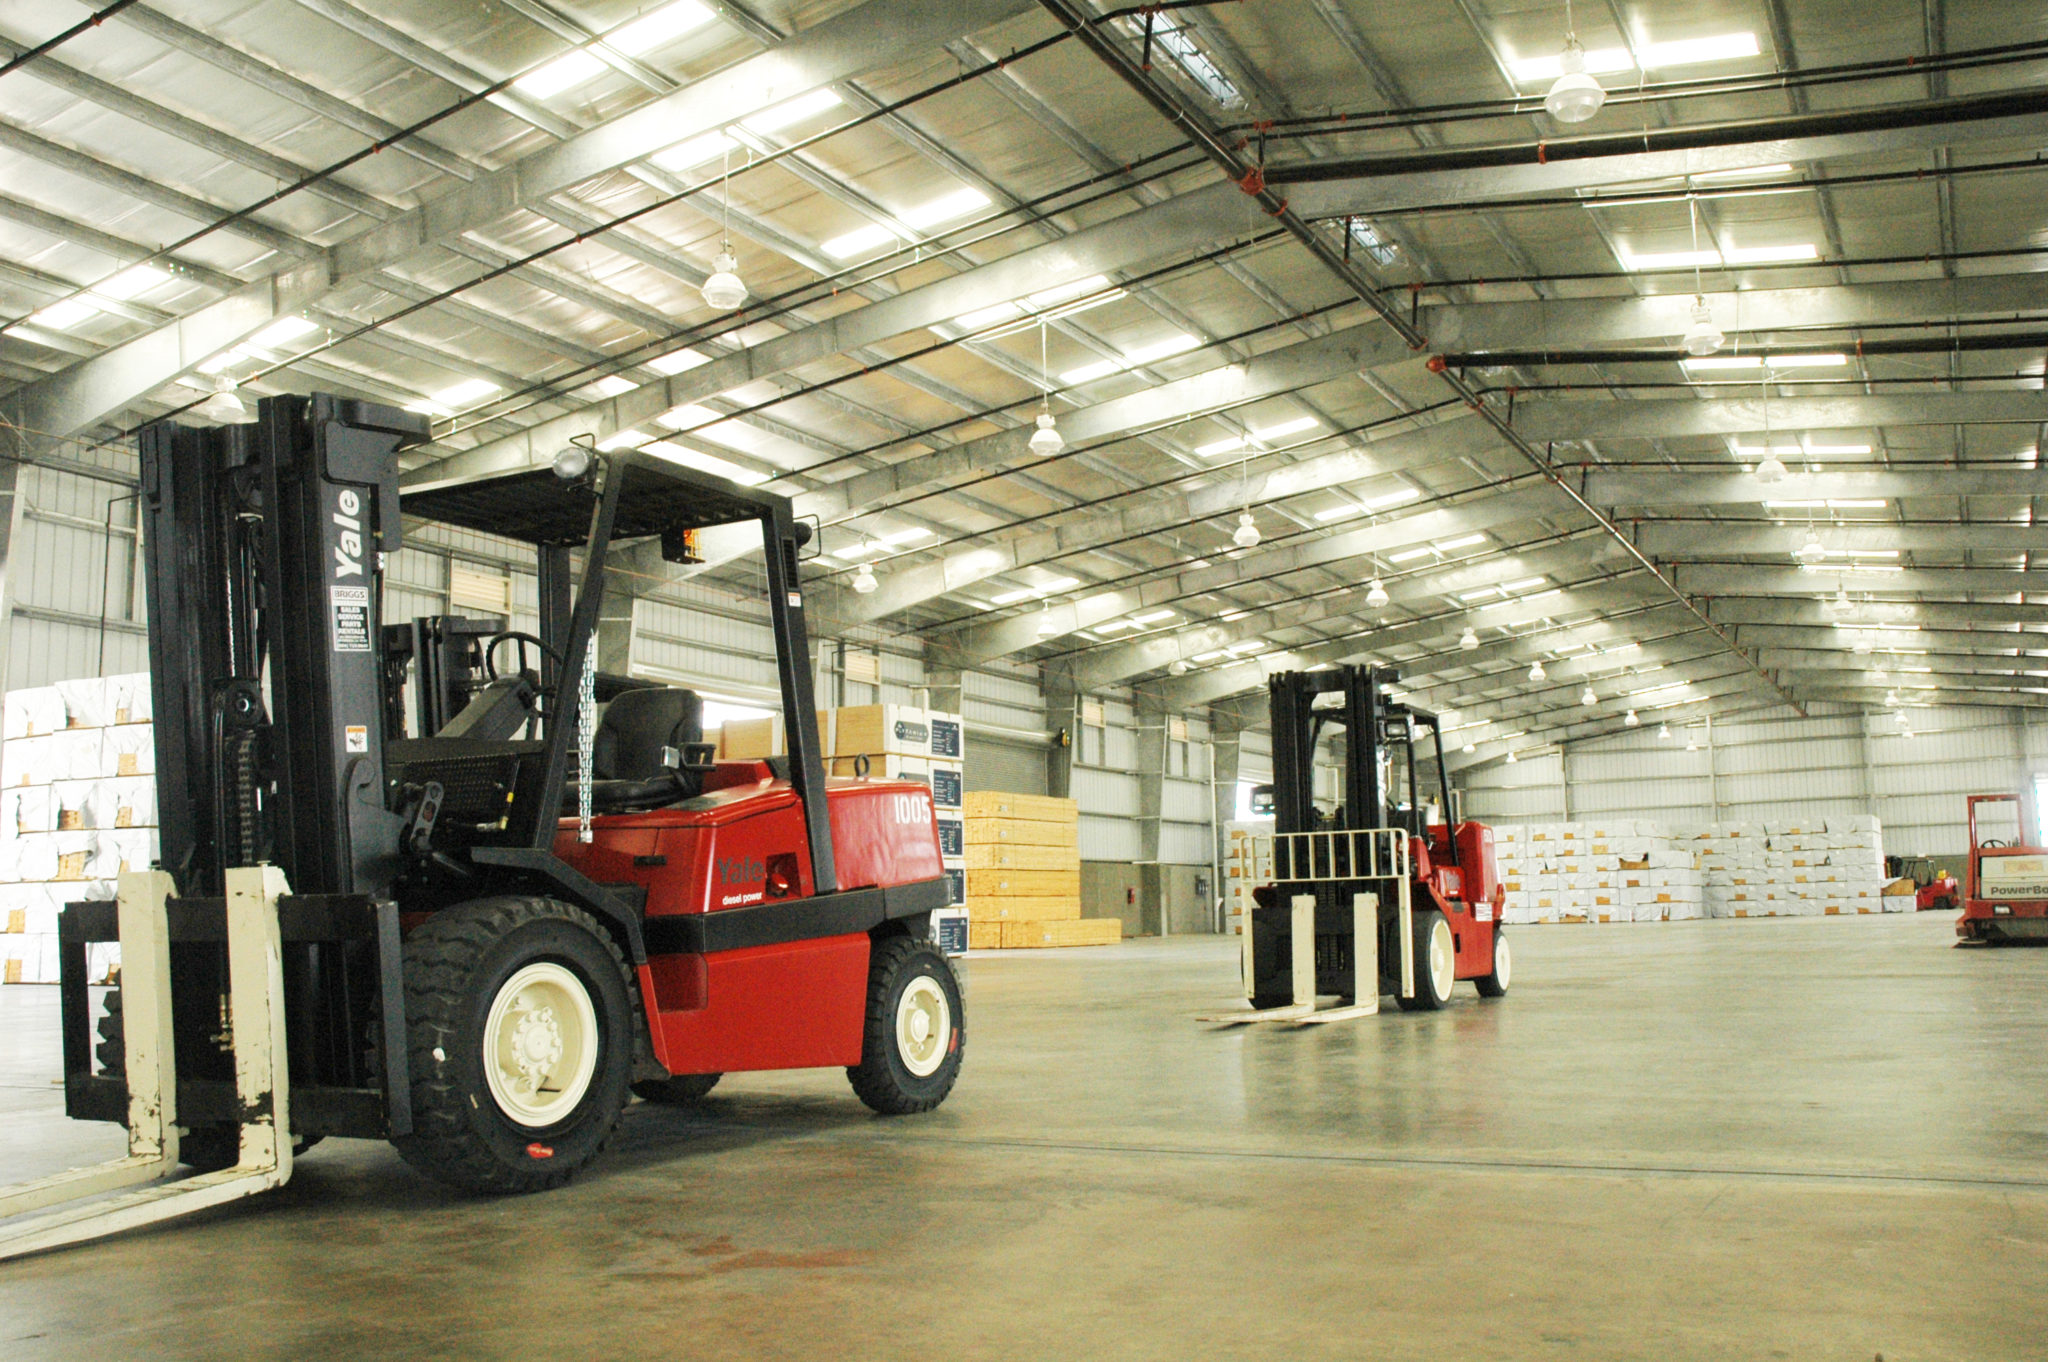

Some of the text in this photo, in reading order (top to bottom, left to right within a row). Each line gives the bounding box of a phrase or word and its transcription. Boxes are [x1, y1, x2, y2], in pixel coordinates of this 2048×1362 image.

[333, 489, 363, 578] Yale
[334, 590, 365, 599] BRIGGS
[894, 795, 932, 825] 1005
[717, 856, 764, 885] Yale
[722, 892, 762, 905] diesel power
